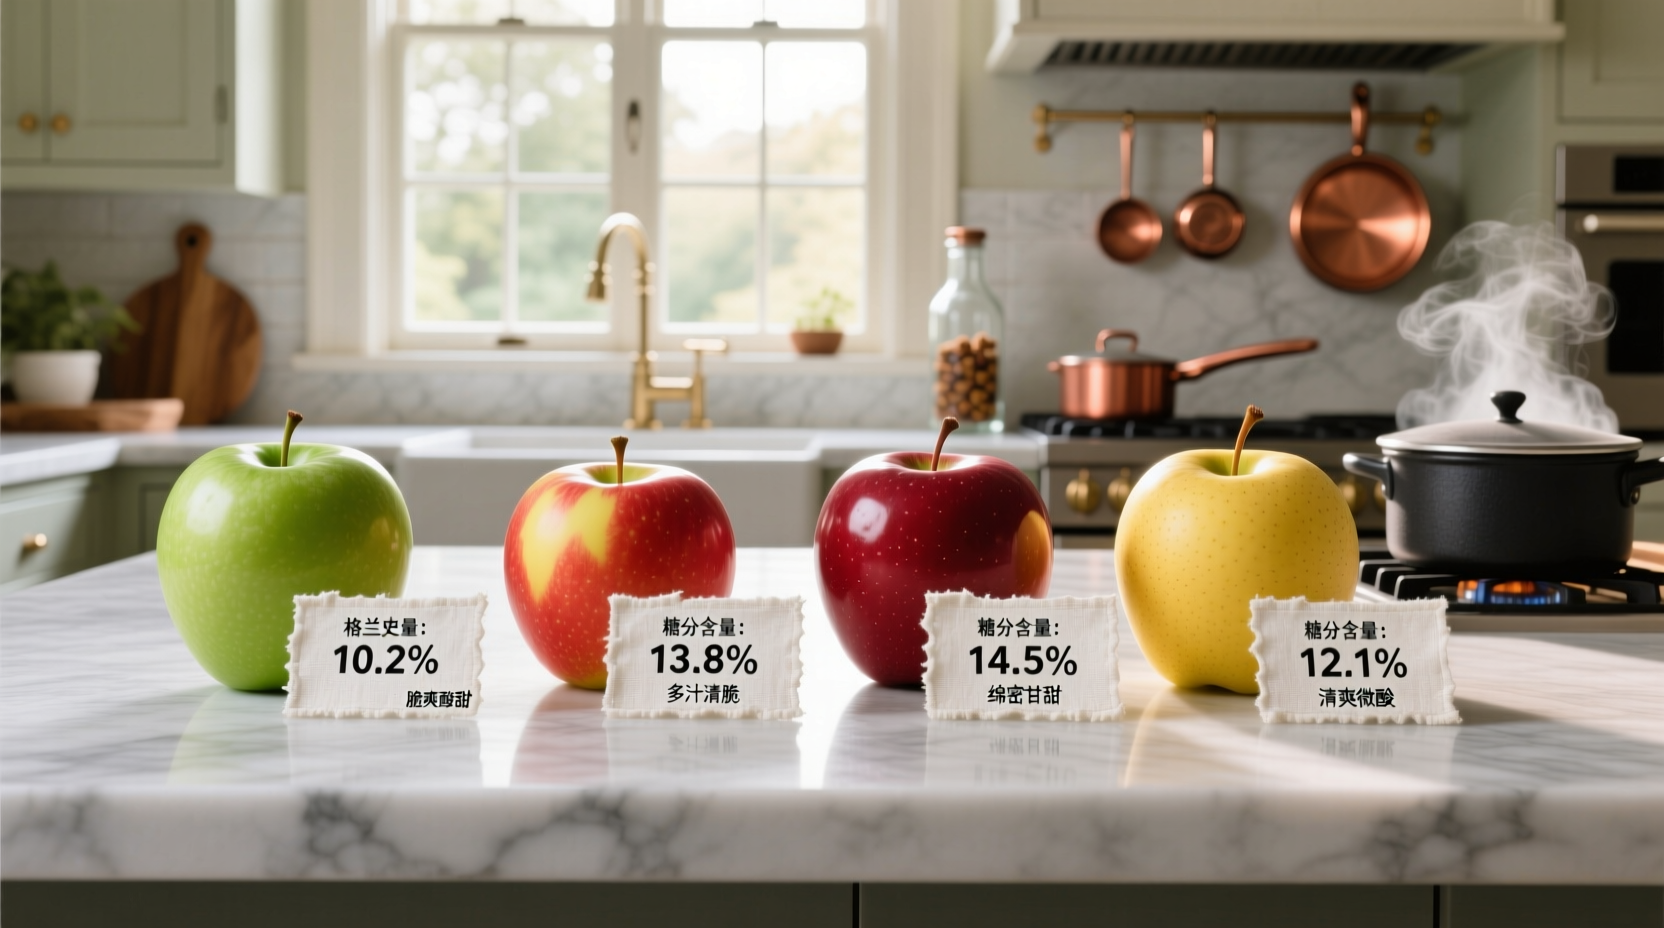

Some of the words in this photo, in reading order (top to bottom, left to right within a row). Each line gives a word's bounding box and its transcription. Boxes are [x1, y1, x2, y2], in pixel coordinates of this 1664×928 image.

[333, 644, 439, 675] 10.2%
[650, 643, 758, 675] 13.8%
[969, 645, 1078, 676] 14.5%
[1300, 646, 1408, 679] 12.1%
[667, 682, 741, 704] 多汁清脆
[987, 683, 1063, 705] 绵密甘甜
[1318, 686, 1396, 709] 清爽微酸
